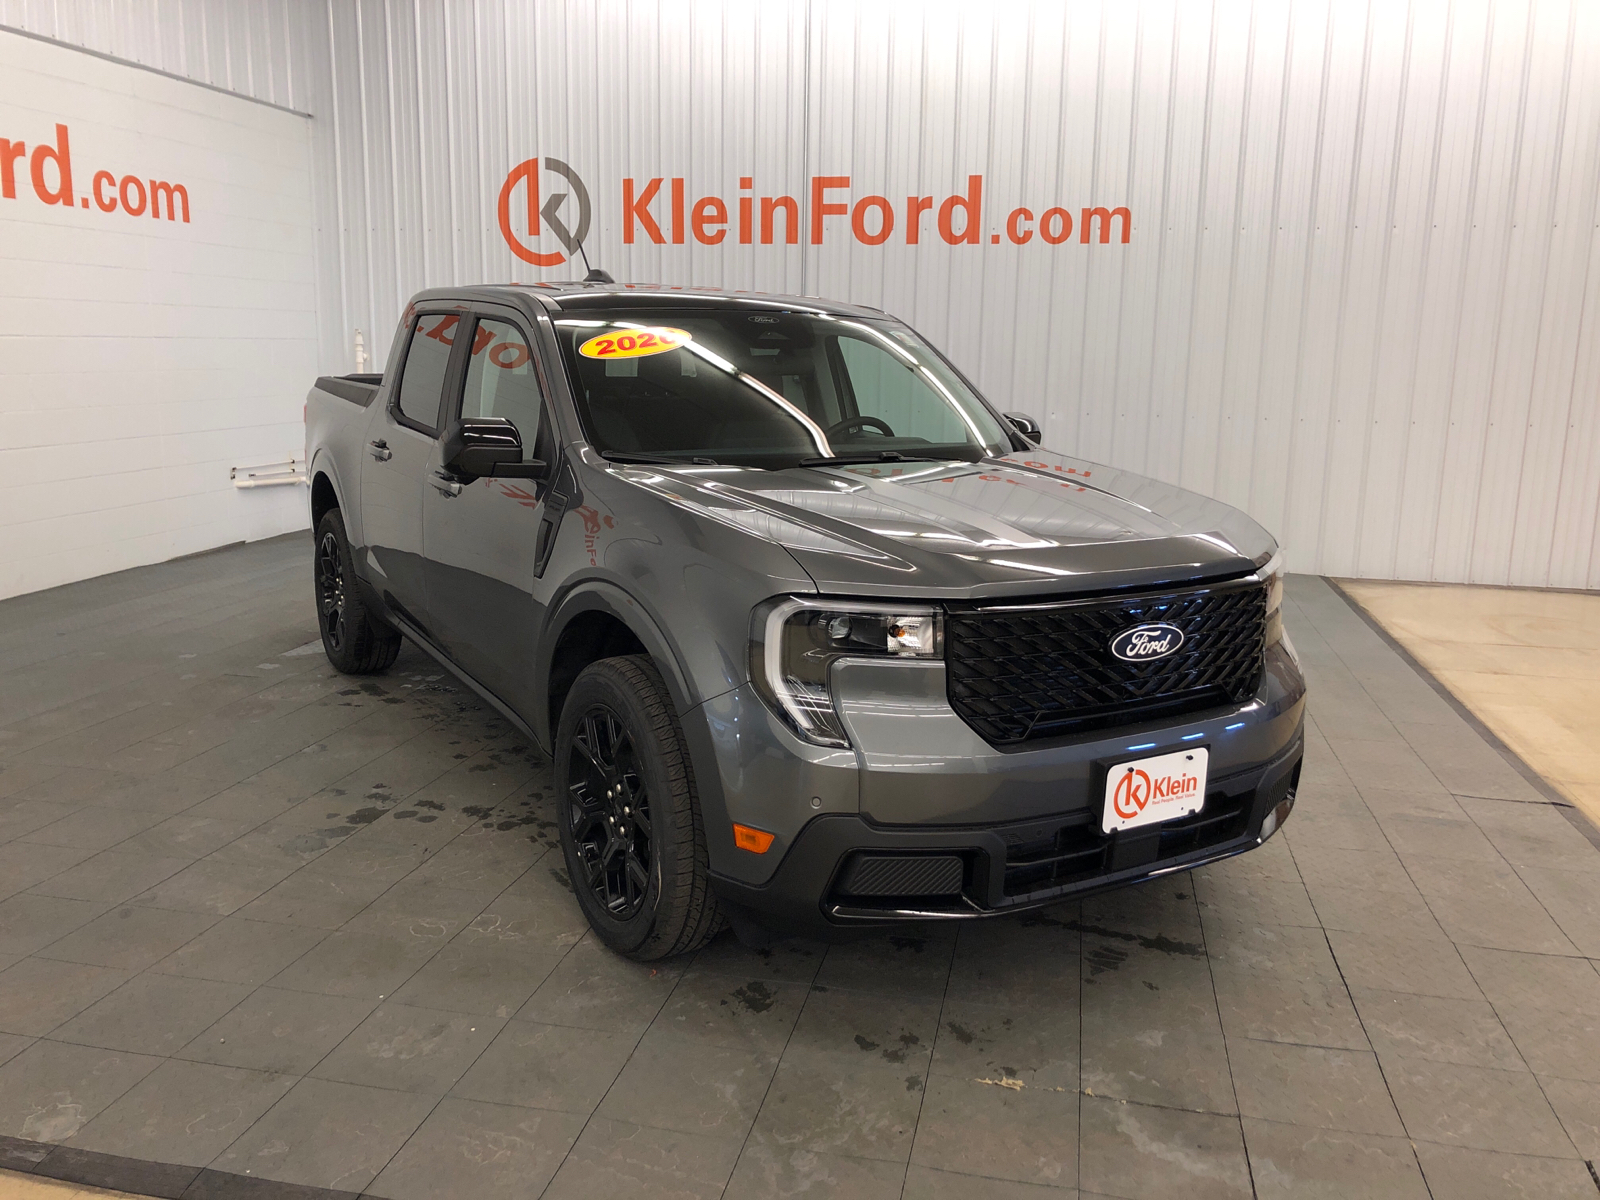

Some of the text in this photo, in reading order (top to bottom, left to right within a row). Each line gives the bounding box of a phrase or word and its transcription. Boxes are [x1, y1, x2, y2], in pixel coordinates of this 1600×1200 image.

[0, 123, 190, 223] rd.com
[622, 175, 1132, 246] KleinFord.com
[1126, 630, 1171, 657] Ford
[1152, 772, 1198, 799] Klein
